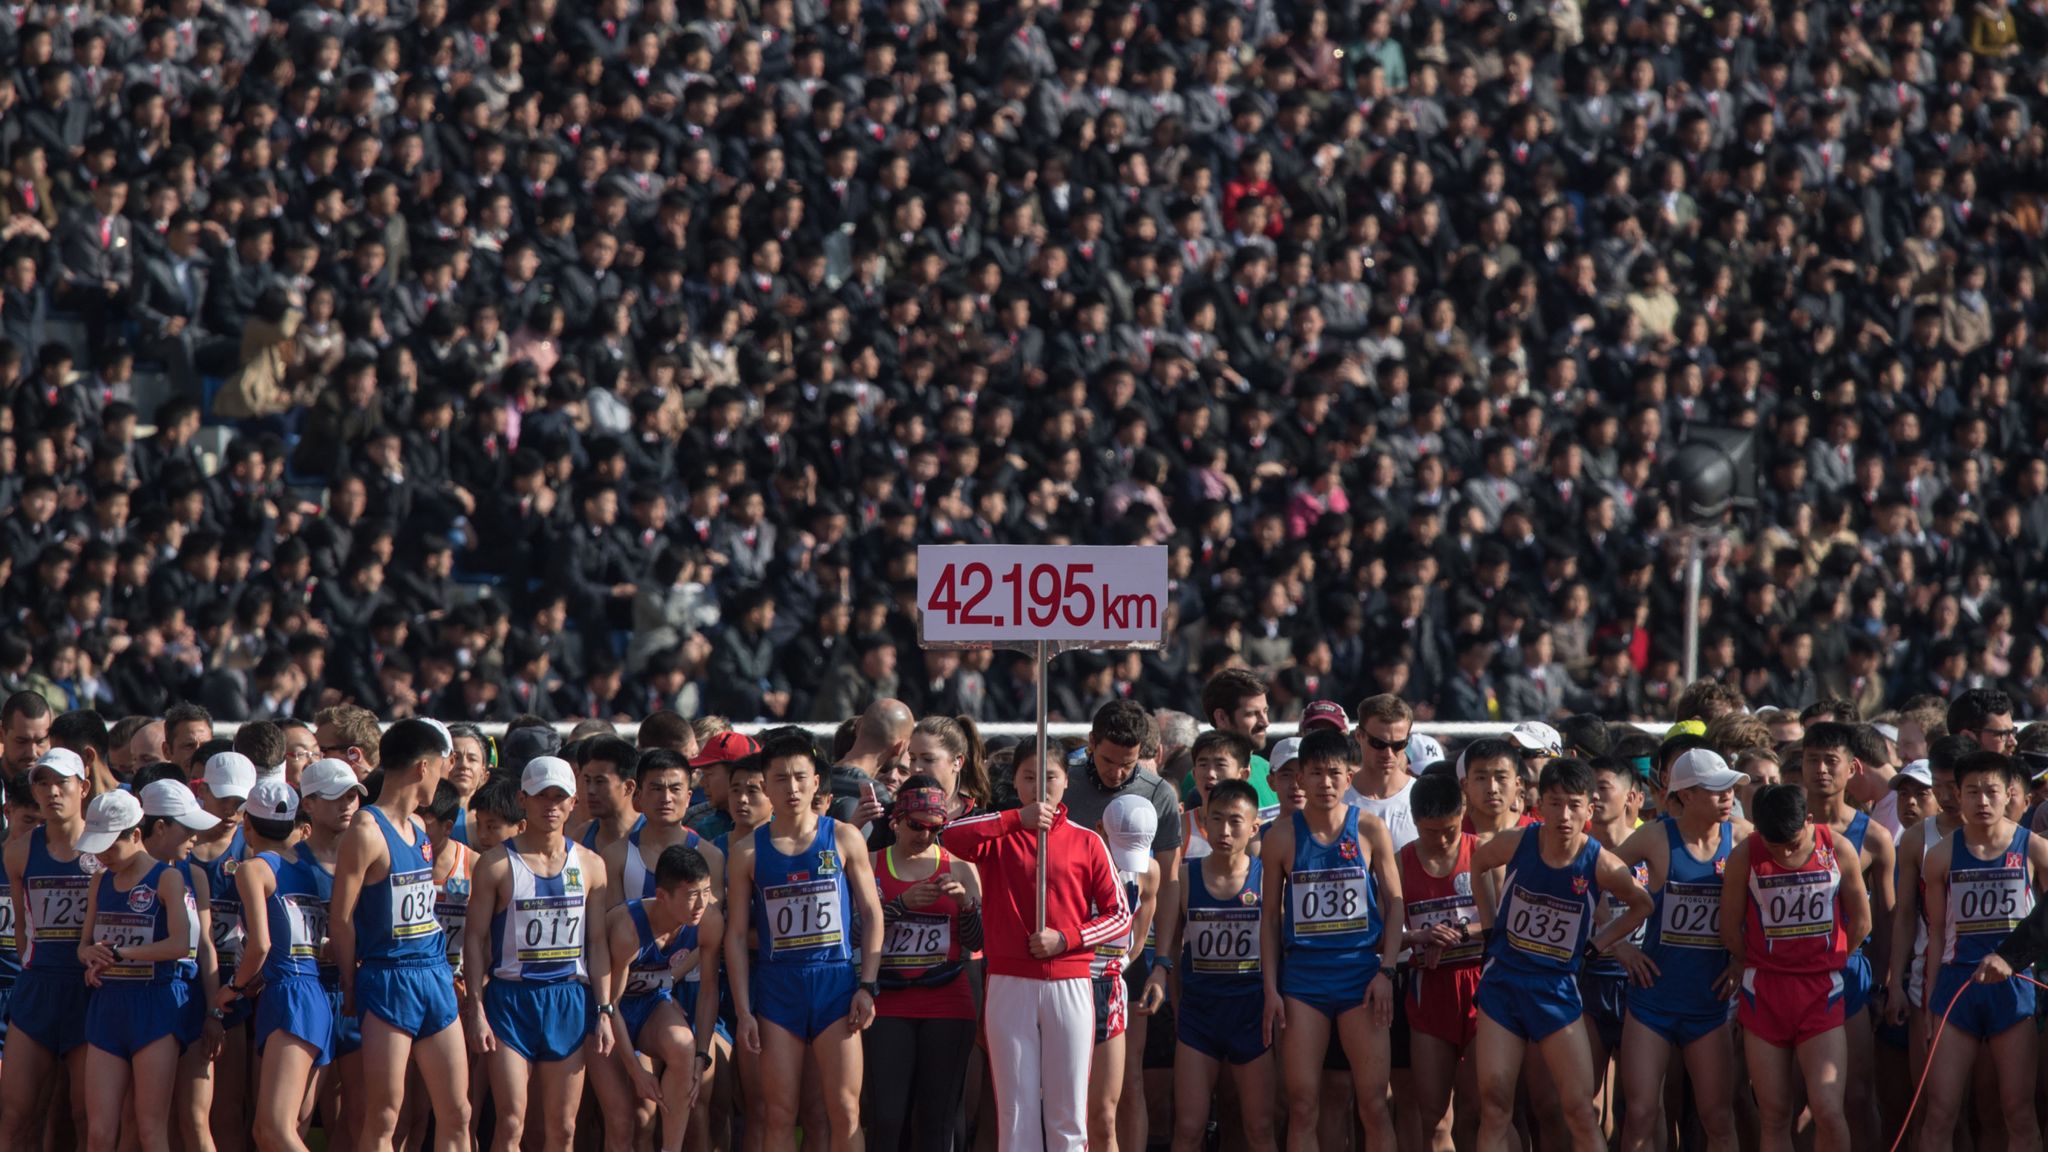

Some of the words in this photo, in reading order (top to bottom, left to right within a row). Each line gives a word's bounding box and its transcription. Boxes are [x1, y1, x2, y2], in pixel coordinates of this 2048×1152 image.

[928, 562, 1095, 627] 42.195
[1102, 583, 1157, 629] km
[42, 897, 88, 926] 123
[777, 901, 831, 935] 015
[1302, 888, 1357, 919] 038
[1770, 892, 1825, 923] 046
[1961, 888, 2017, 918] 005
[525, 916, 579, 946] 017
[888, 928, 942, 953] 1218
[1514, 909, 1571, 943] 035
[1198, 930, 1252, 957] 006
